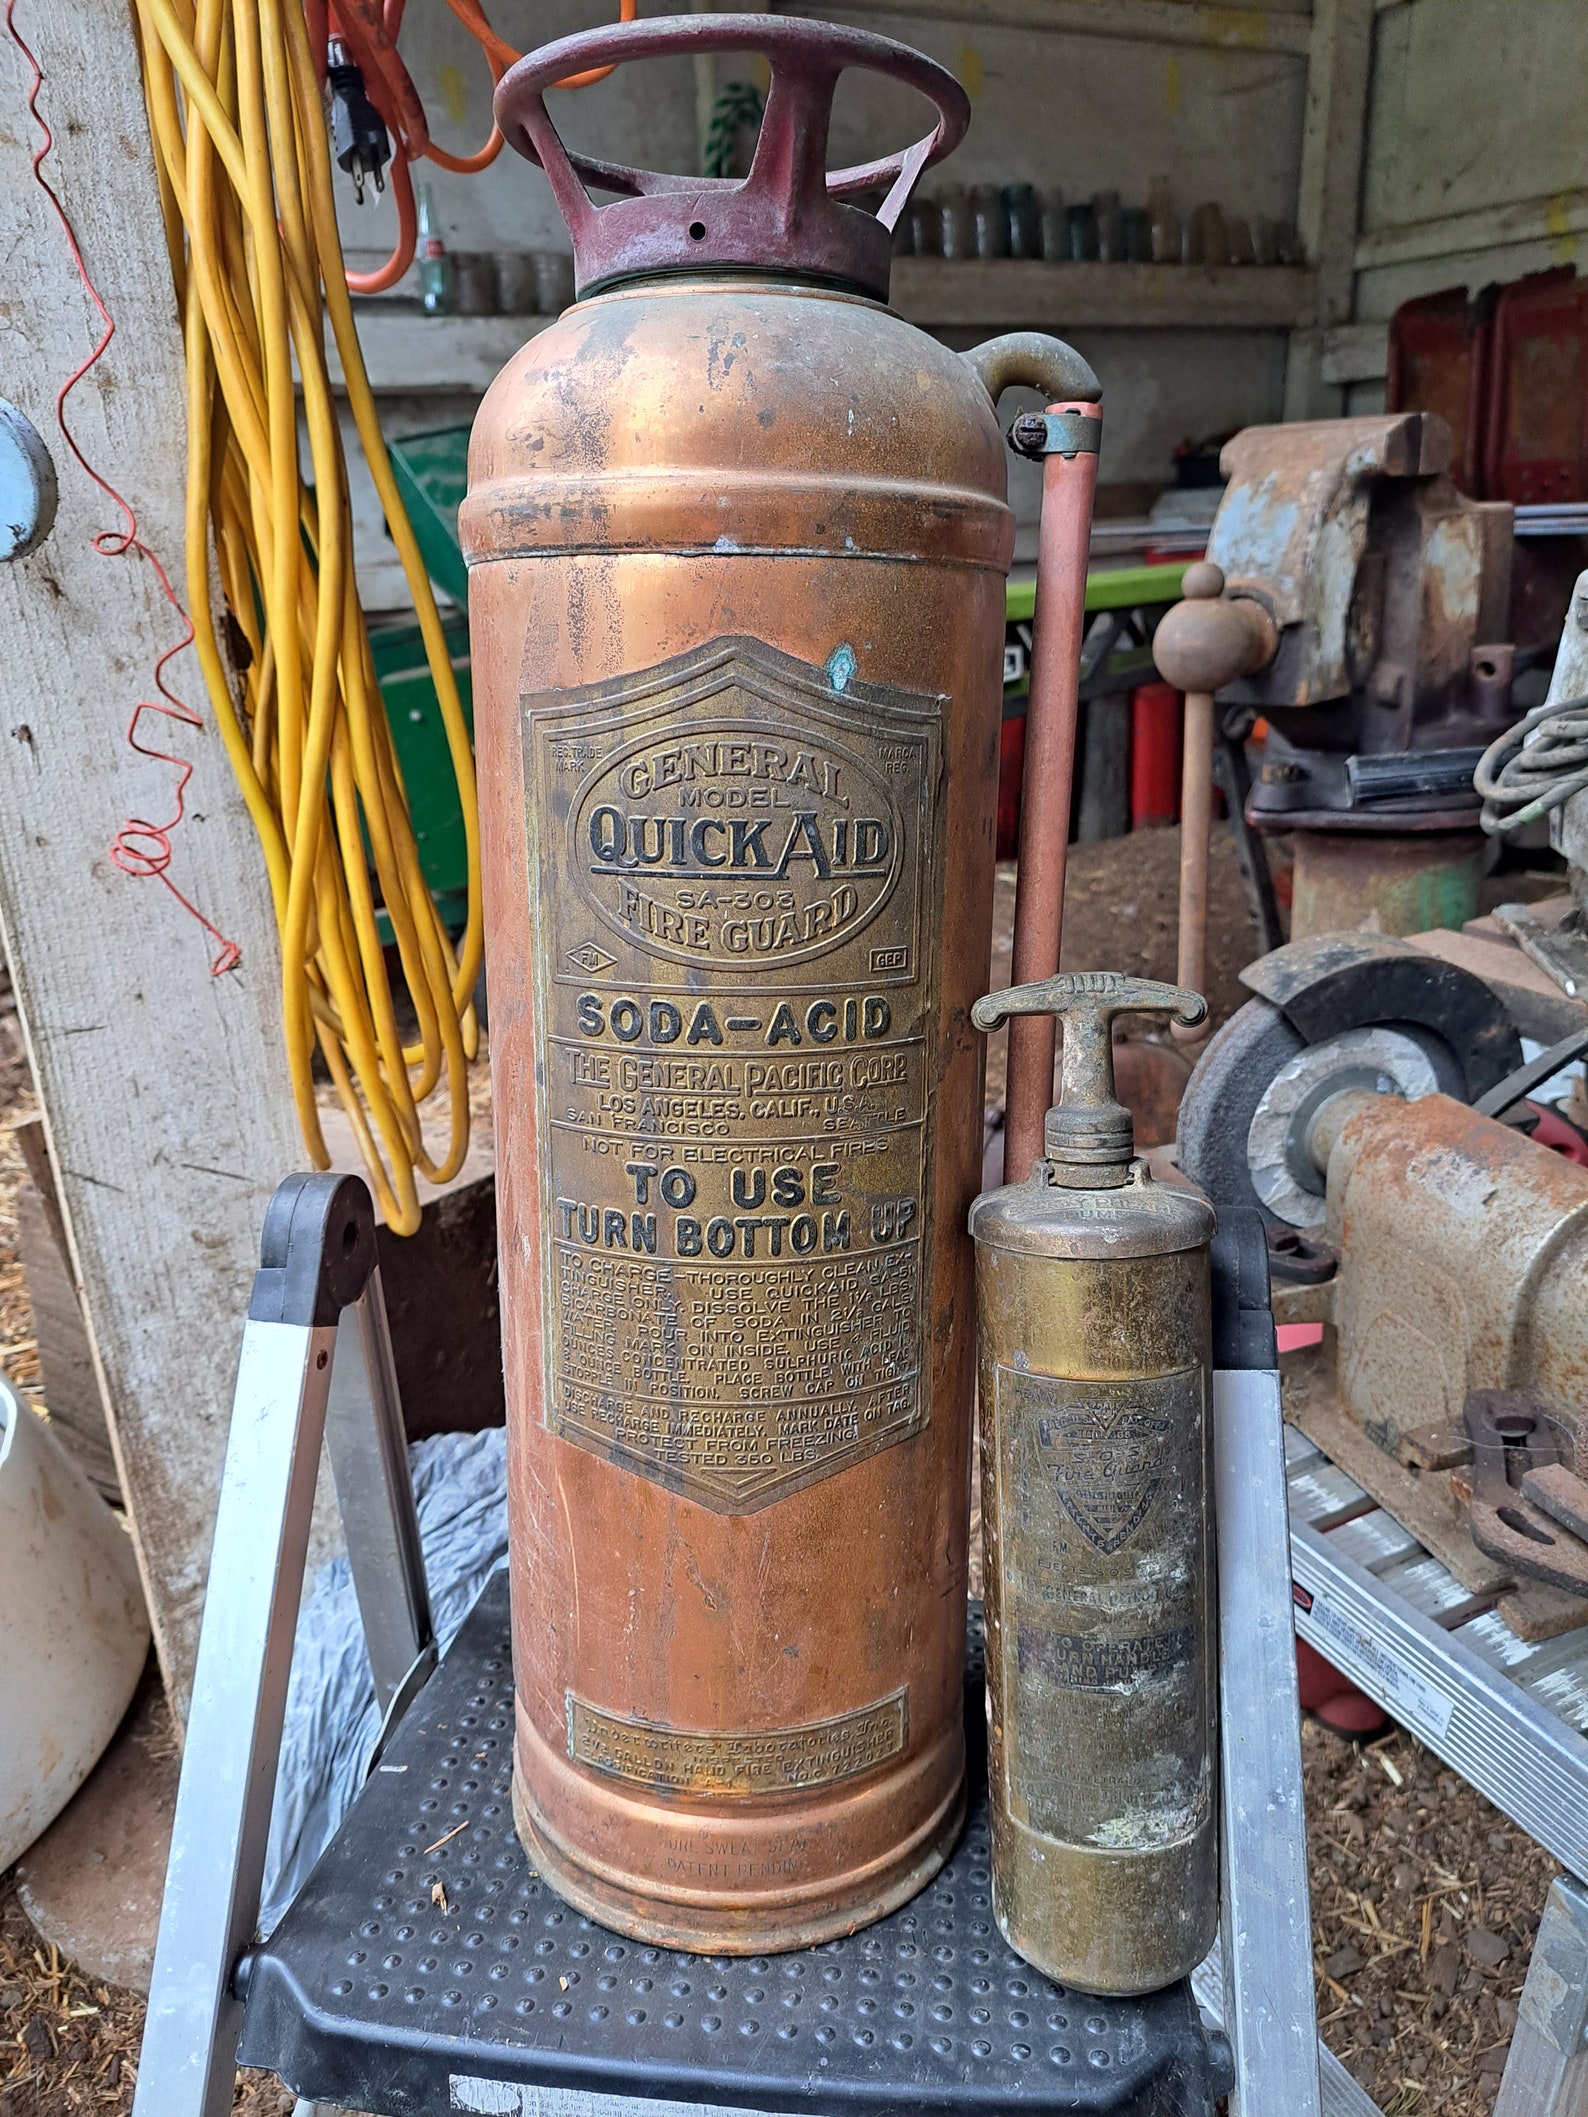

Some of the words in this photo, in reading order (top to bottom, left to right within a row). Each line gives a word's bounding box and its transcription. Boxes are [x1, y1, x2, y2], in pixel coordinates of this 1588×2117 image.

[554, 759, 585, 773] MARK
[878, 746, 917, 759] MARCA
[885, 761, 910, 774] REG.
[620, 740, 850, 810] GENERAL
[679, 786, 792, 808] MODEL
[615, 879, 710, 950] FIRE
[721, 884, 859, 953] GUARD
[676, 889, 796, 910] SA-303
[580, 950, 599, 967] FM
[565, 1047, 611, 1089] THE
[619, 1056, 741, 1097] GENERAL
[745, 1059, 844, 1097] PACIFIC
[599, 1092, 636, 1113] LOS
[825, 1094, 875, 1114] U.S.A.
[567, 1108, 601, 1125] SAN
[612, 1115, 730, 1135] FRANCISCO
[823, 1108, 906, 1131] SEATTLE
[582, 1136, 623, 1155] NOT
[631, 1143, 674, 1161] FOR
[682, 1145, 826, 1164] ELECTRICAL
[831, 1137, 888, 1159] FIRES
[625, 1162, 696, 1209] TO
[731, 1163, 842, 1210] USE
[557, 1197, 657, 1254] TURN
[675, 1210, 850, 1258] BOTTOM
[871, 1200, 916, 1243] UP
[560, 1249, 583, 1268] TO
[589, 1258, 671, 1283] CHARGE
[822, 1258, 878, 1279] CLEAN
[885, 1252, 912, 1267] EX-
[711, 1286, 753, 1300] USE
[766, 1279, 859, 1299] QUICKAID
[869, 1265, 915, 1285] SA-51
[561, 1280, 625, 1306] CHARGE
[632, 1297, 686, 1313] ONLY.
[692, 1301, 791, 1314] DISSOLVE
[802, 1296, 840, 1310] THE
[879, 1280, 913, 1297] LBS.
[561, 1294, 678, 1326] BICARBONATE
[691, 1317, 717, 1328] OF
[732, 1316, 788, 1328] SODA
[801, 1313, 819, 1325] IN
[562, 1321, 616, 1346] FILLING
[626, 1337, 677, 1354] MARK
[687, 1344, 714, 1357] ON
[724, 1343, 790, 1358] INSIDE.
[805, 1337, 841, 1352] USE
[851, 1334, 862, 1345] 4
[870, 1320, 912, 1342] FLUID
[637, 1325, 688, 1341] POUR
[701, 1331, 744, 1344] INTO
[757, 1314, 884, 1343] EXTINGUISHER
[893, 1308, 912, 1321] TO
[562, 1335, 615, 1359] OUNCES
[621, 1349, 750, 1373] CONCENTRATED
[764, 1349, 853, 1370] SULPHURIC
[859, 1340, 892, 1358] ACID
[579, 1353, 622, 1375] OUNCE
[714, 1371, 762, 1385] PLACE
[841, 1358, 872, 1375] WITH
[563, 1362, 614, 1387] STOPPLE
[624, 1378, 638, 1391] IN
[650, 1383, 721, 1399] POSITION.
[740, 1385, 794, 1398] SCREW
[805, 1381, 835, 1394] CAP
[846, 1374, 865, 1388] ON
[564, 1384, 633, 1415] DISCHARGE
[641, 1406, 671, 1420] AND
[680, 1409, 767, 1425] RECHARGE
[869, 1385, 911, 1408] AFTER
[565, 1401, 586, 1416] USE
[591, 1409, 660, 1433] RECHARGE
[667, 1421, 768, 1438] IMMEDIATELY.
[778, 1420, 818, 1436] MARK
[824, 1413, 859, 1430] DATE
[864, 1407, 882, 1422] ON
[887, 1398, 912, 1414] TAG.
[615, 1428, 698, 1450] PROTECT
[706, 1439, 759, 1452] FROM
[654, 1448, 728, 1466] TESTED
[779, 1450, 821, 1464] LBS.
[1047, 1464, 1094, 1481] Fire
[1103, 1449, 1166, 1481] Guard
[1059, 1492, 1105, 1548] PATENTS
[1114, 1492, 1153, 1548] PENDING
[1038, 1559, 1085, 1575] EJECTS
[1082, 1637, 1165, 1652] OPERATE
[1101, 1651, 1170, 1665] HANDLE
[1060, 1664, 1097, 1677] AND
[614, 1746, 675, 1772] GALLON
[683, 1763, 727, 1777] HAND
[734, 1763, 773, 1777] FIRE
[782, 1728, 895, 1774] EXTINGUISHER
